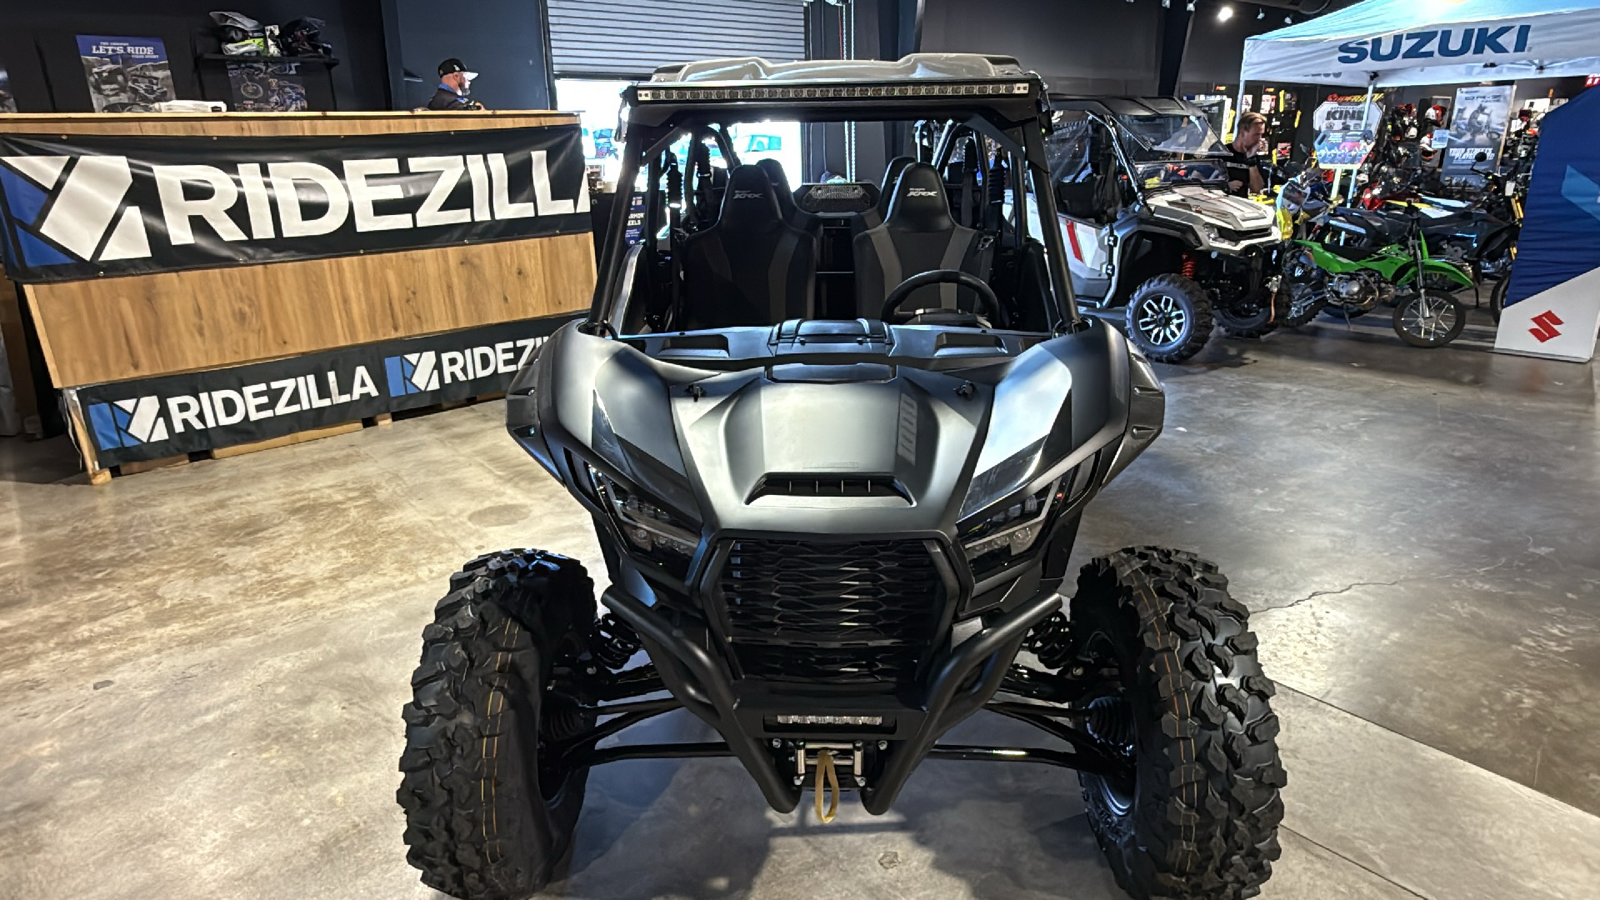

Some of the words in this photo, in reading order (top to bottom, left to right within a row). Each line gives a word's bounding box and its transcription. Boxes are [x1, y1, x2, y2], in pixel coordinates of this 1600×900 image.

[92, 45, 123, 55] LET'S
[127, 46, 154, 54] RIDE
[1338, 25, 1531, 64] SUZUKI
[441, 335, 550, 385] RIDEZ
[166, 365, 380, 434] RIDEZILLA
